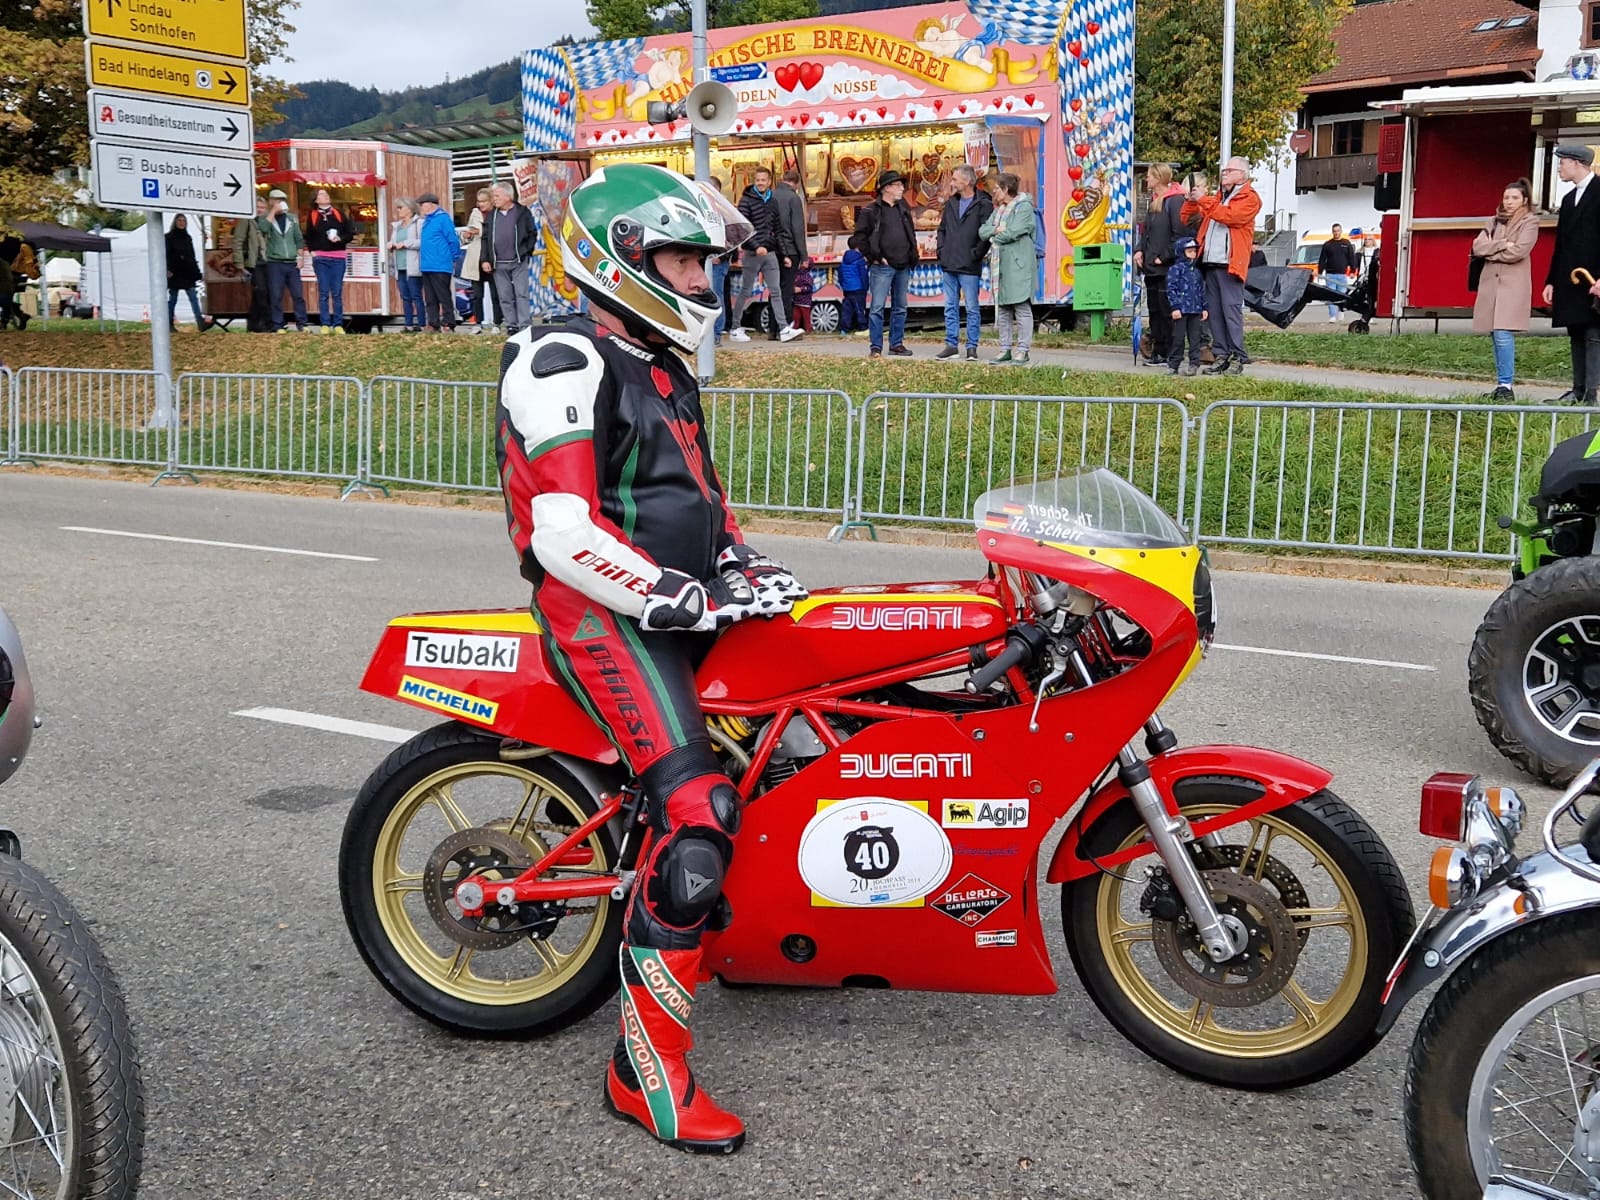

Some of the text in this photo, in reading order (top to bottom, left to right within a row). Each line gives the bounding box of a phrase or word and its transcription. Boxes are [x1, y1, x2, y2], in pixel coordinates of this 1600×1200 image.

[128, 0, 172, 18] Lindau
[130, 18, 196, 41] Sonthofen
[813, 30, 950, 82] BRENNEREI
[99, 58, 190, 86] Bad Hindelang
[833, 80, 878, 95] NÜSSE
[118, 109, 215, 133] Gesundheitszentrum
[141, 159, 217, 179] Busbahnhof
[165, 184, 218, 201] Kurhaus
[1010, 515, 1084, 541] Th. Scherr
[831, 606, 962, 631] DUCATI
[411, 636, 516, 667] Tsubaki
[402, 680, 493, 719] MICHELIN
[839, 753, 972, 778] DUCATI
[977, 802, 1027, 826] Agip
[855, 841, 890, 870] 40
[946, 899, 998, 910] CARBURATORI
[964, 914, 978, 922] INC
[977, 934, 1016, 944] CHAMPION
[641, 957, 693, 1020] daytona
[624, 1001, 662, 1093] daytona
